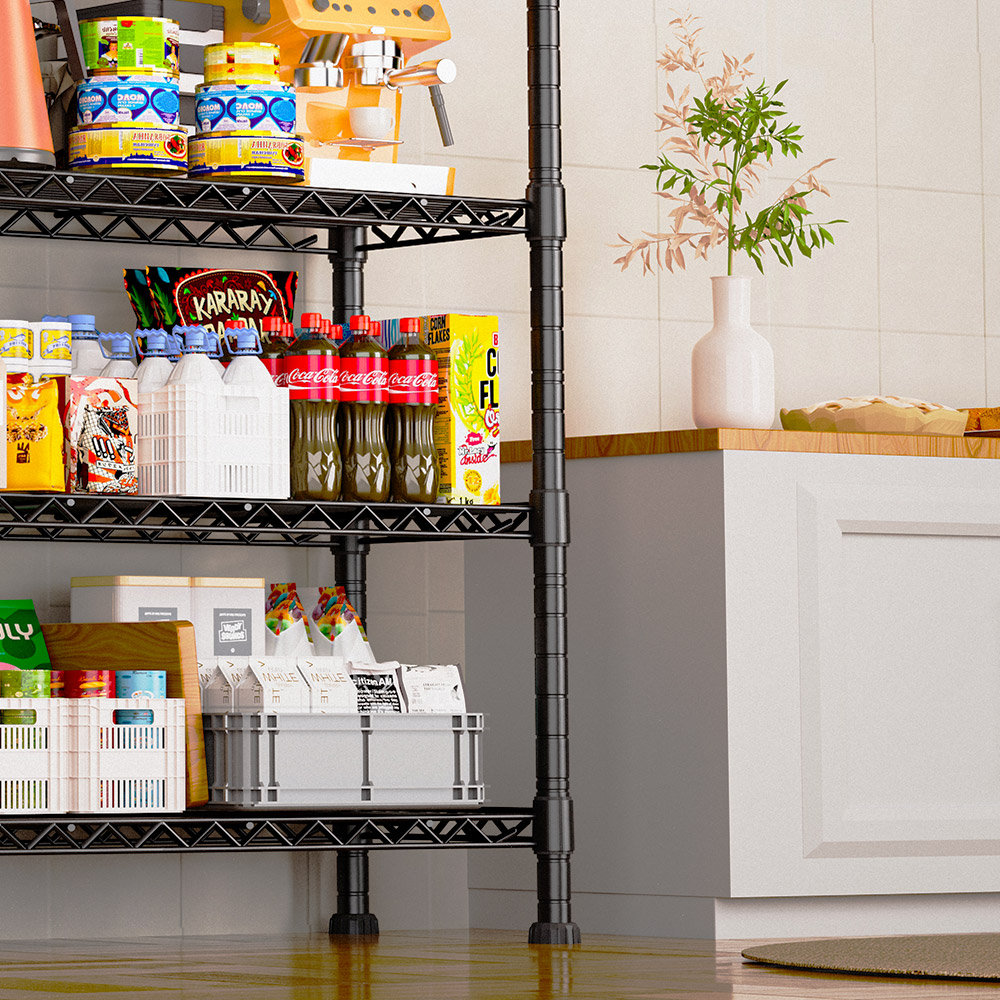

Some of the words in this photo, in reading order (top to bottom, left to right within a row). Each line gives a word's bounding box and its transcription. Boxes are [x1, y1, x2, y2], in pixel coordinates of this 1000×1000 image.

[193, 288, 273, 321] KARARAY
[430, 315, 446, 331] CORN
[428, 328, 450, 345] FLAKES
[289, 368, 339, 384] Coca-Cola
[340, 370, 388, 386] Coca-Cola
[389, 372, 438, 388] Coca-Cola
